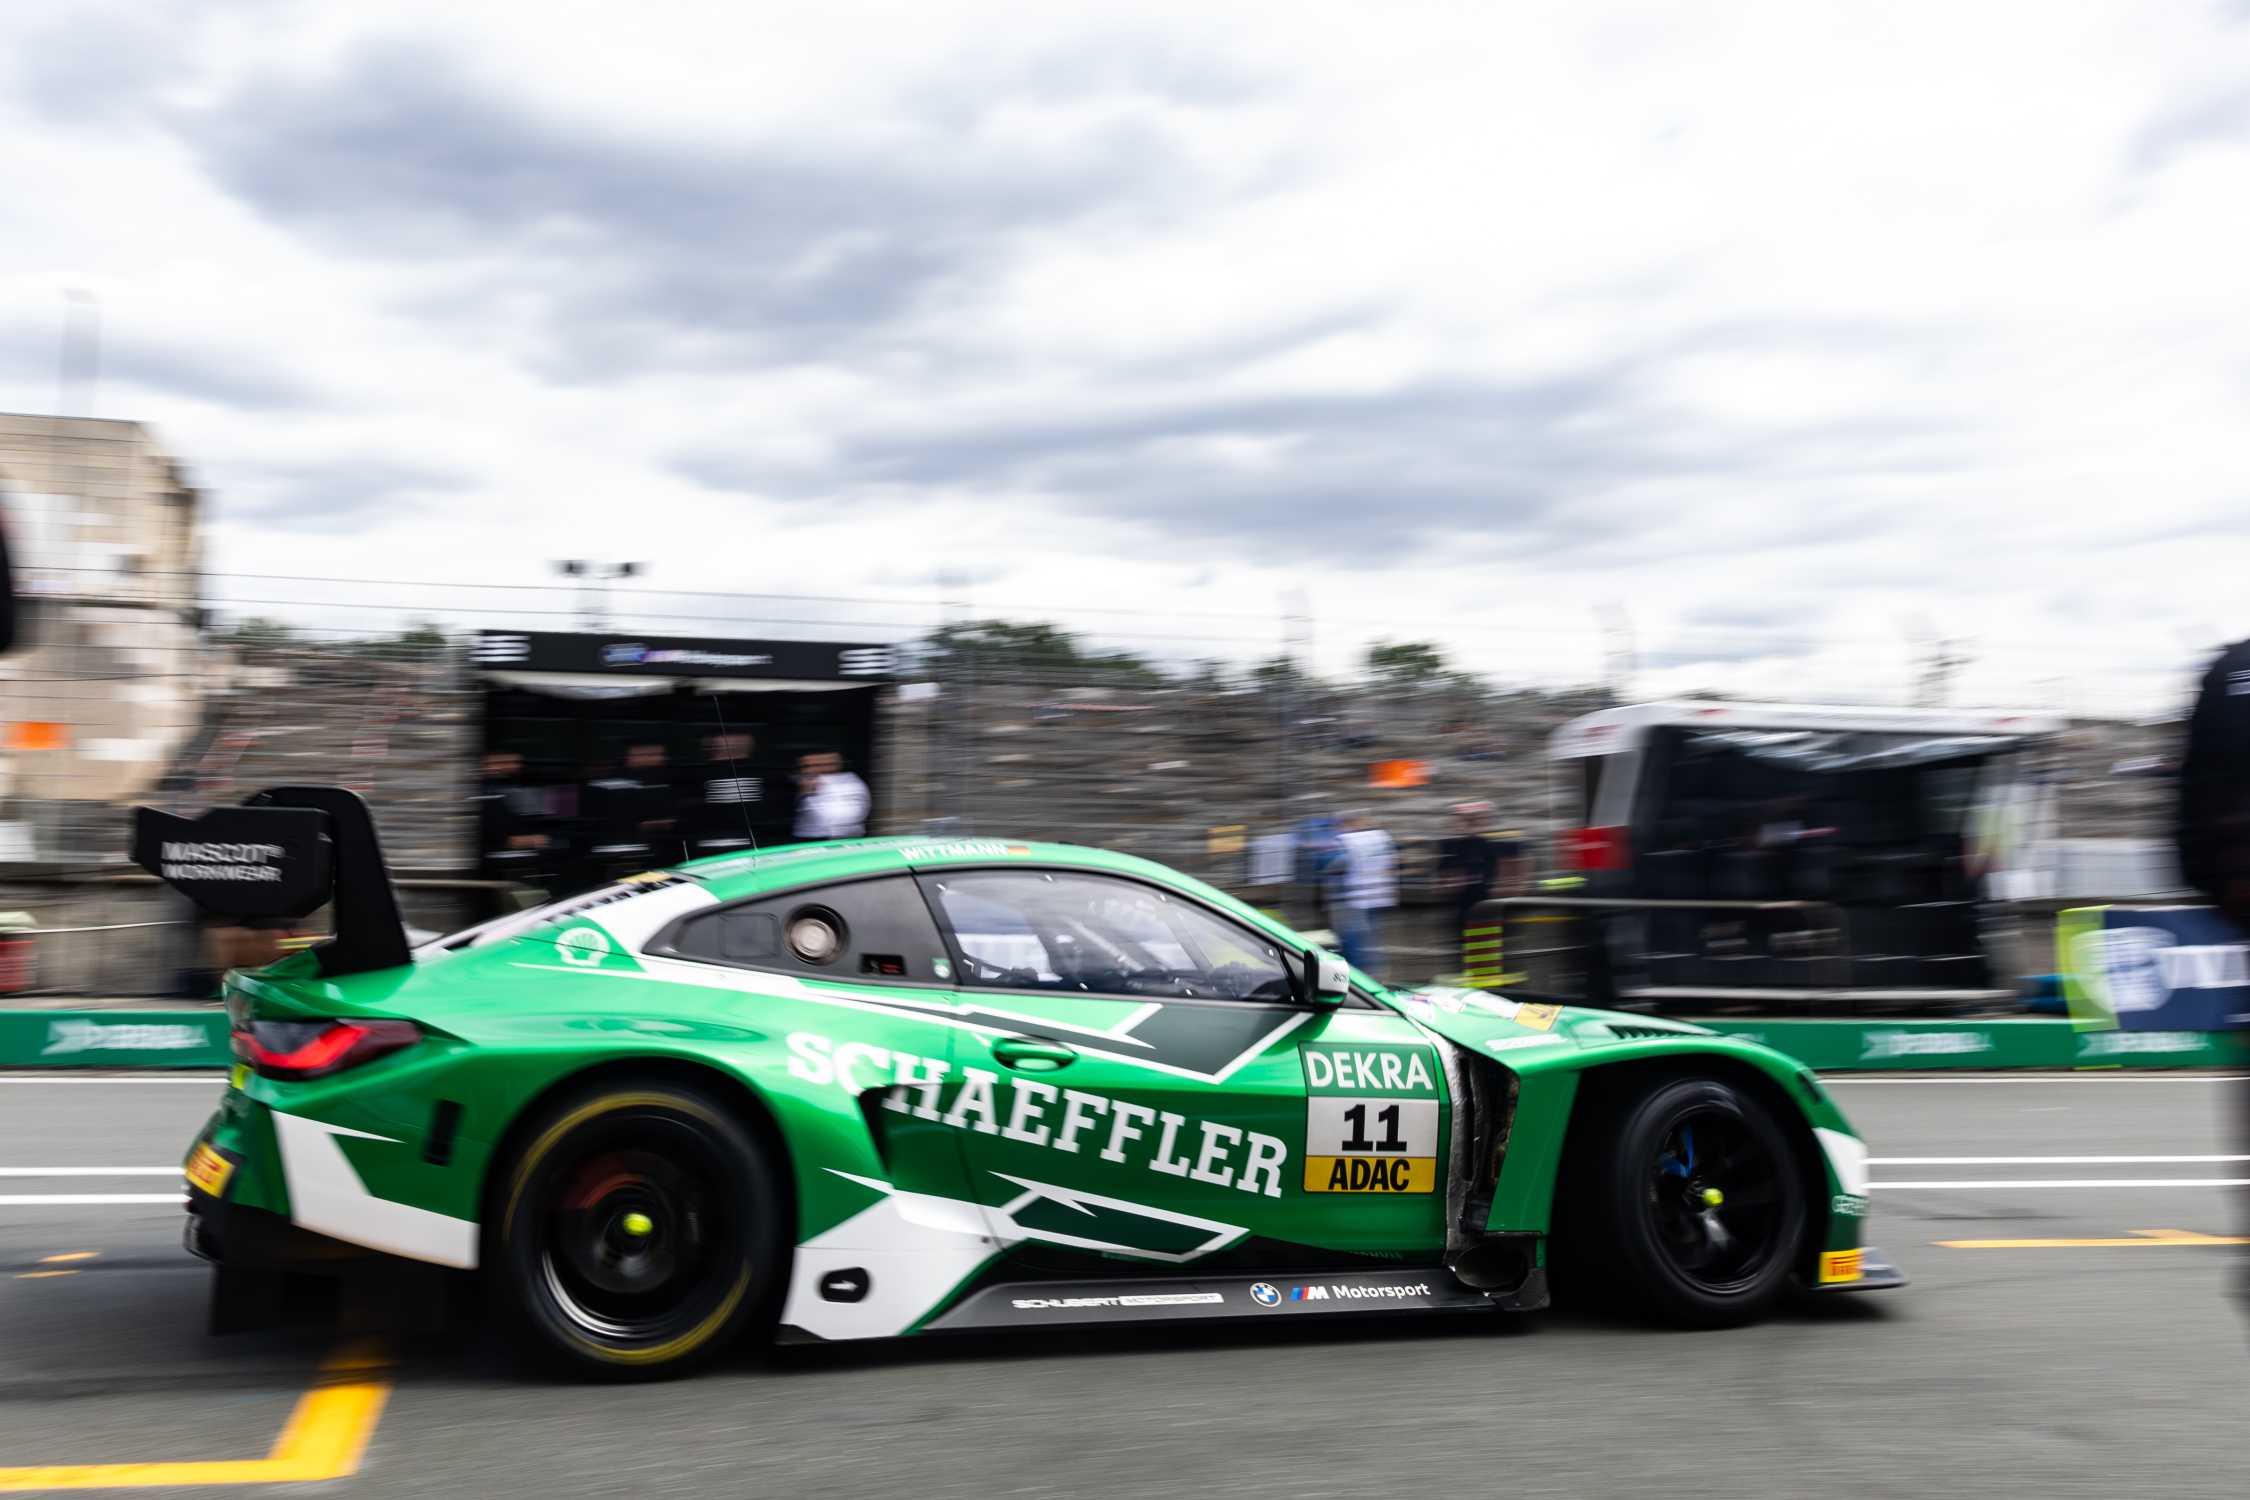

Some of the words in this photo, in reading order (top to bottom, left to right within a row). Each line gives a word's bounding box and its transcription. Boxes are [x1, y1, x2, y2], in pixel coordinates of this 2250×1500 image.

[899, 843, 1009, 861] WITTMANN
[1305, 1051, 1434, 1090] DEKRA
[785, 1031, 1289, 1199] SCHAEFFLER
[1341, 1103, 1408, 1152] 11
[1327, 1158, 1411, 1192] ADAC
[1012, 1296, 1120, 1309] SCHUBERT
[1331, 1282, 1432, 1301] Motorsport
